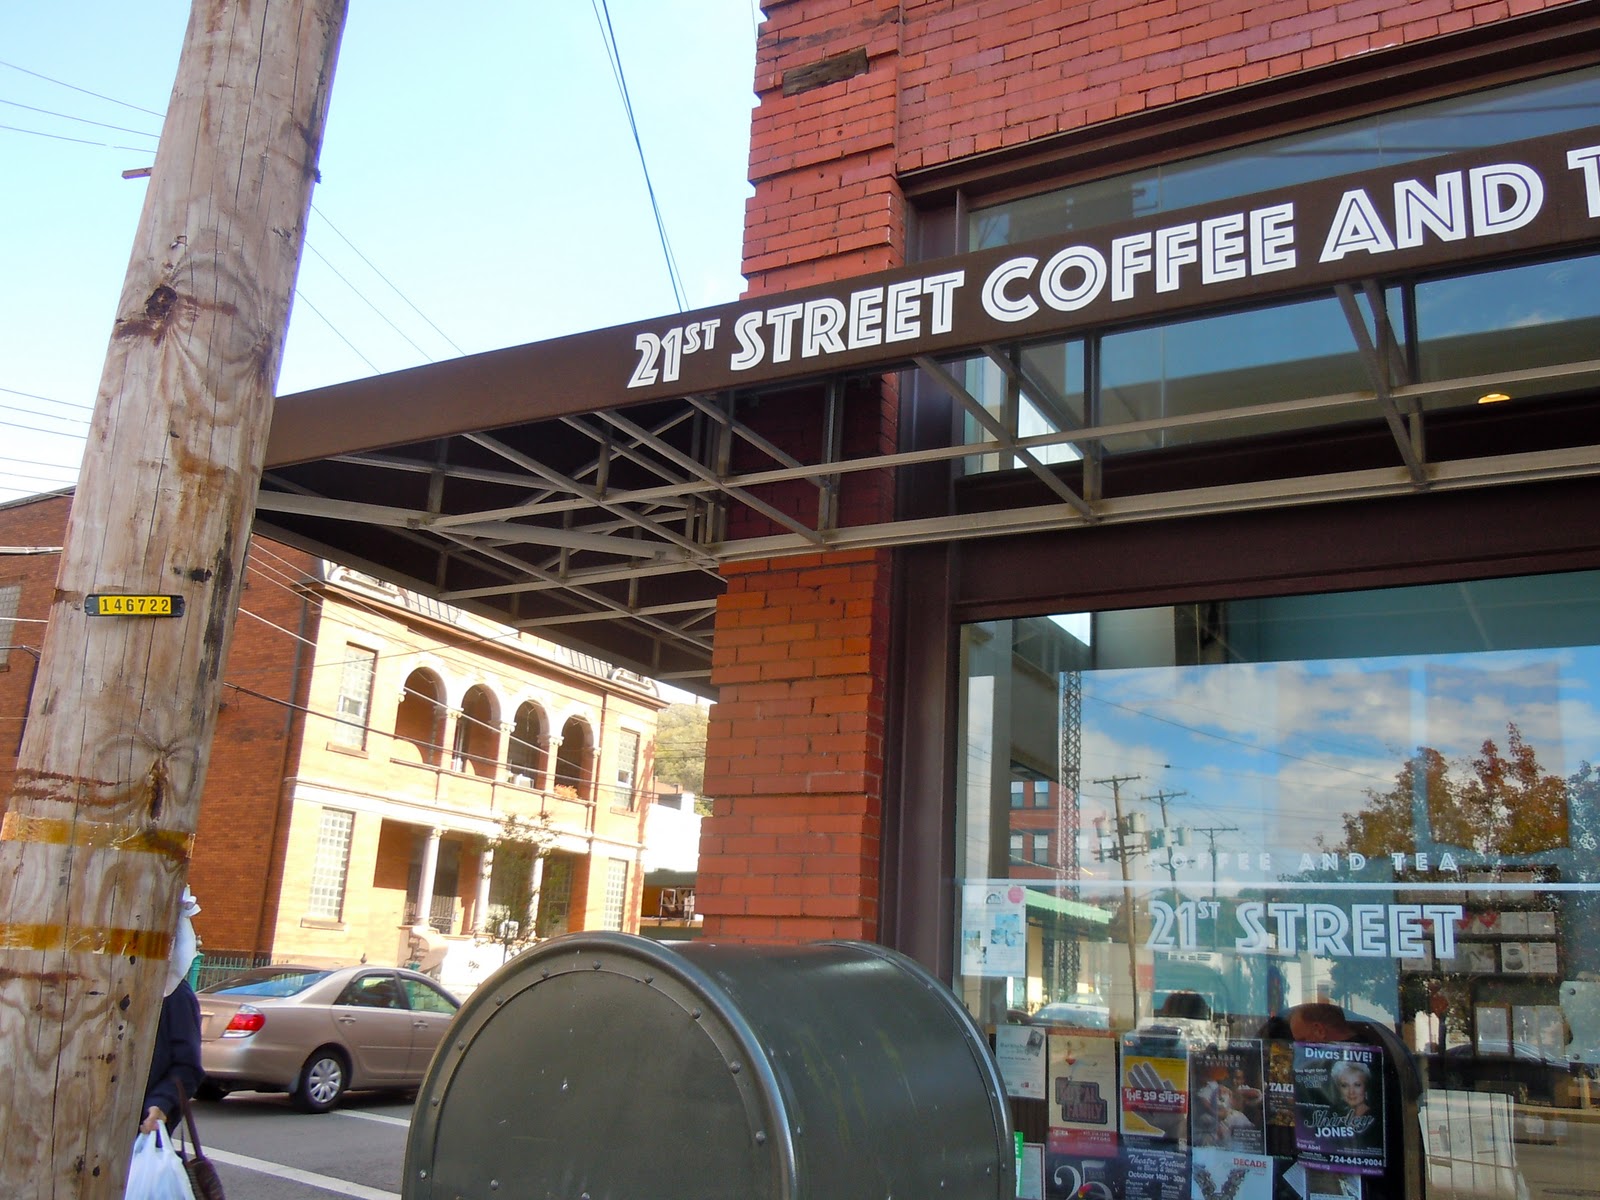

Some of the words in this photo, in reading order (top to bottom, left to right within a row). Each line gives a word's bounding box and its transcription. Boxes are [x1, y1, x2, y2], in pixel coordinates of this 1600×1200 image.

[627, 318, 721, 389] 21ST
[730, 269, 965, 371] STREET
[981, 202, 1296, 322] COFFEE
[1319, 162, 1544, 262] AND
[102, 598, 169, 612] 146722
[1298, 852, 1366, 871] AND
[1391, 852, 1458, 871] TEA
[1146, 900, 1220, 951] 21ST
[1235, 902, 1463, 959] STREET
[1305, 1047, 1340, 1060] Divas
[1343, 1050, 1372, 1062] LIVE!
[1124, 1088, 1142, 1101] THE
[1143, 1091, 1157, 1101] 39
[1158, 1091, 1186, 1104] STEPS
[1303, 1109, 1375, 1134] Shirley
[1314, 1126, 1354, 1138] JONES
[1233, 1157, 1267, 1169] DECADE
[1329, 1155, 1382, 1167] 724-643-9004
[1128, 1171, 1154, 1179] October
